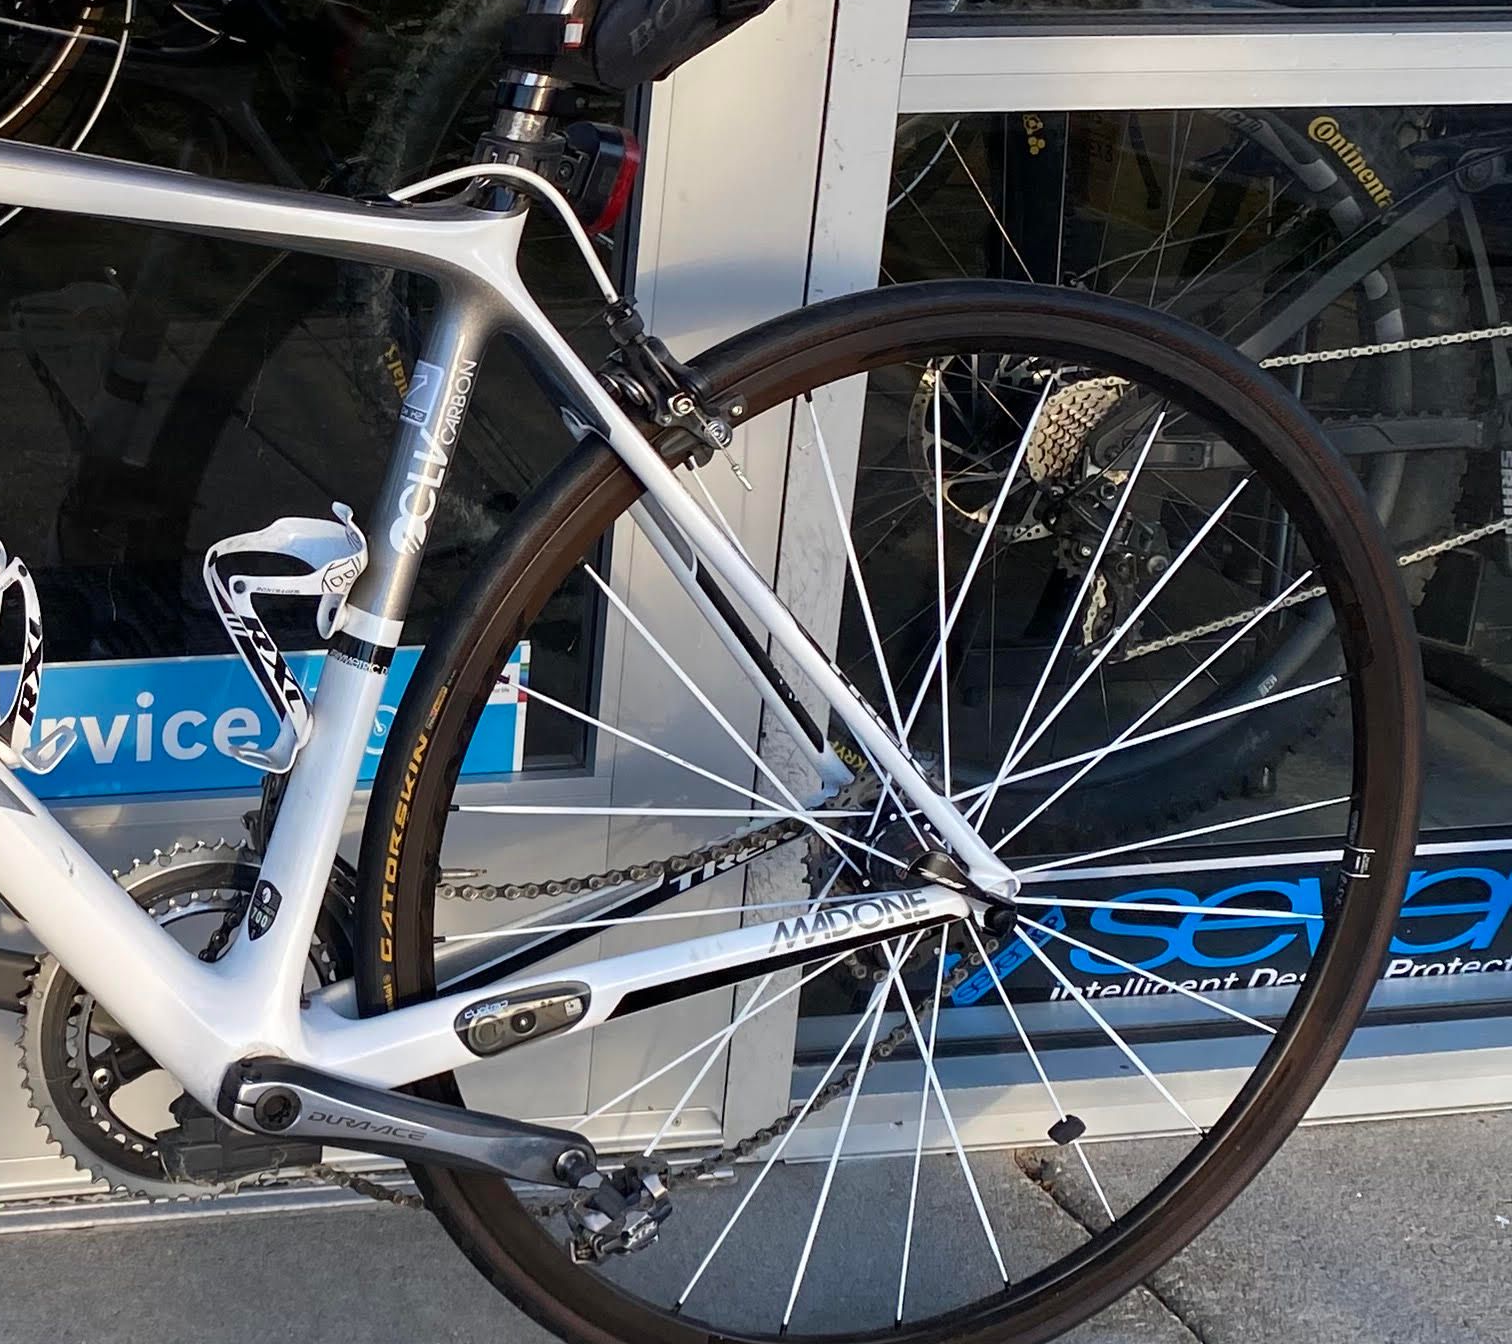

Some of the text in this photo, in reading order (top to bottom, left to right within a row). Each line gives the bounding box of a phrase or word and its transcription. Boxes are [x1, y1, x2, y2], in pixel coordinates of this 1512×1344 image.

[439, 358, 478, 446] CARBON
[379, 733, 429, 963] GATORSKIN
[250, 906, 269, 928] 700
[768, 889, 931, 954] MADONE
[307, 1111, 428, 1142] DURA-ACE
